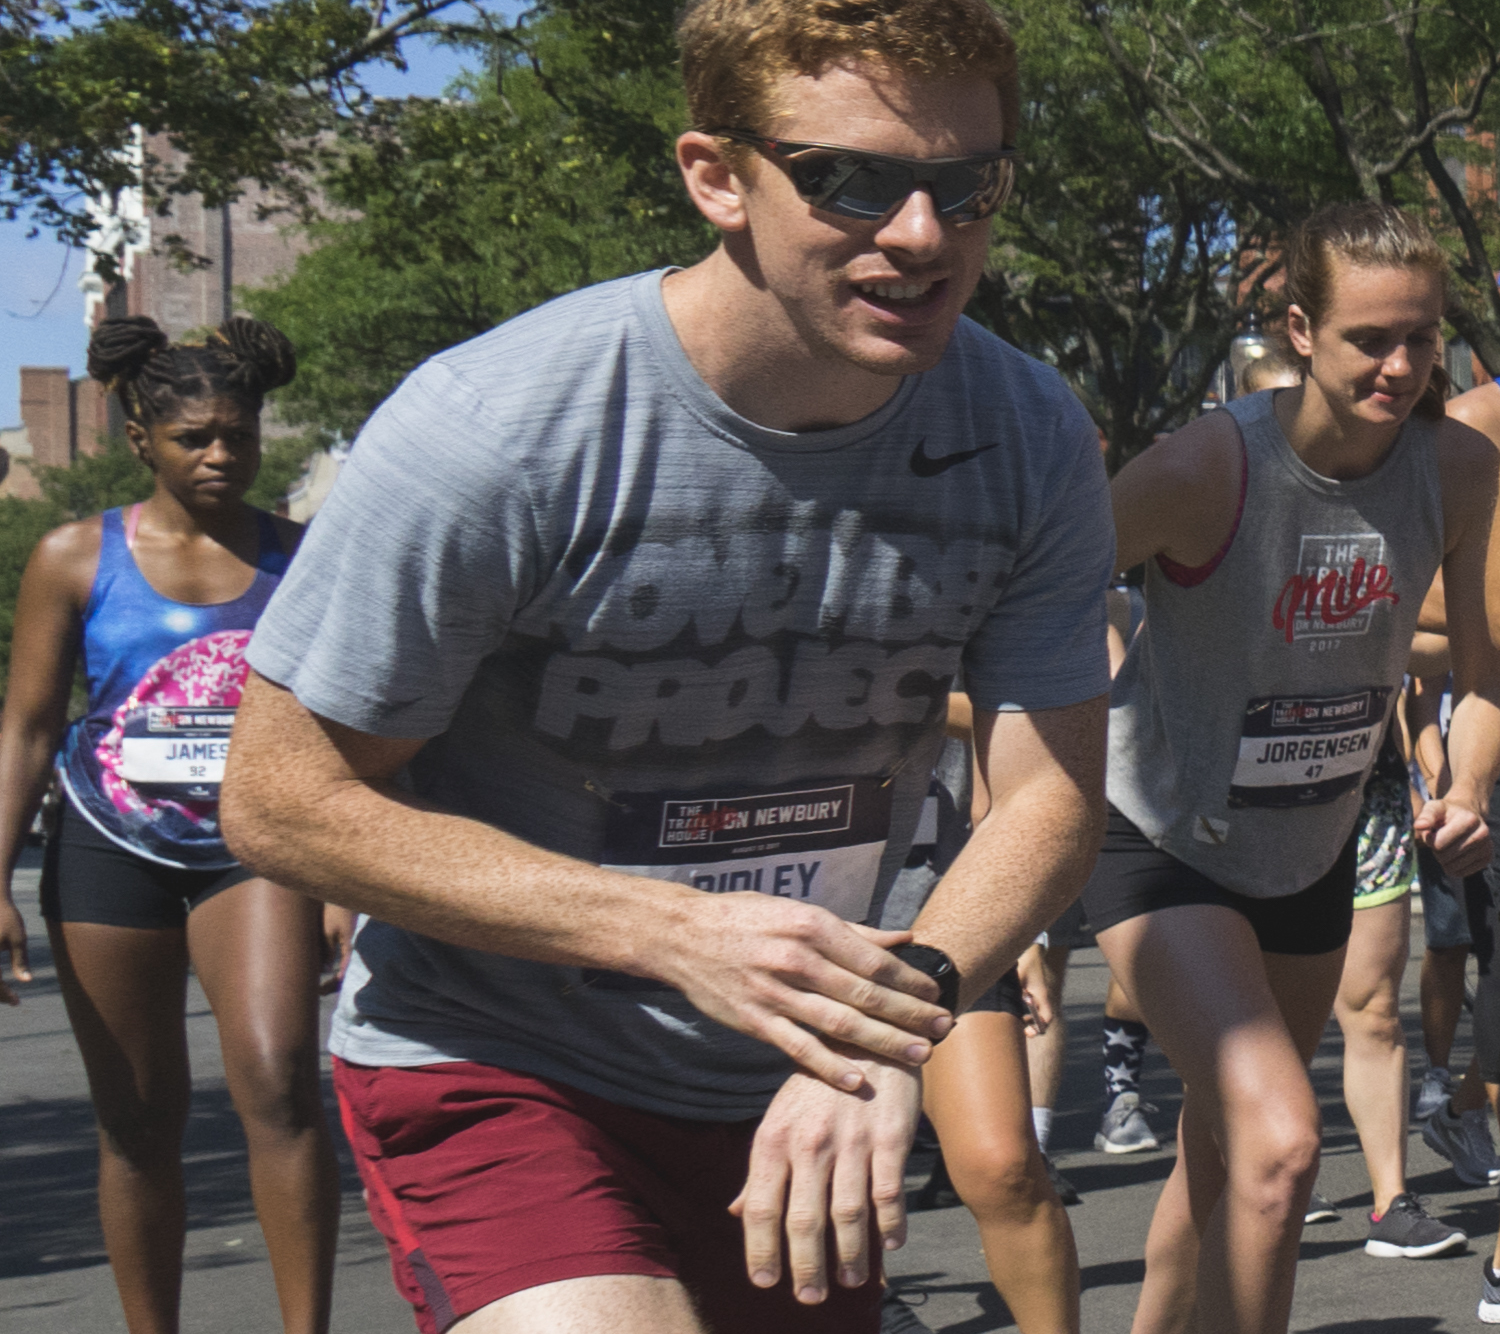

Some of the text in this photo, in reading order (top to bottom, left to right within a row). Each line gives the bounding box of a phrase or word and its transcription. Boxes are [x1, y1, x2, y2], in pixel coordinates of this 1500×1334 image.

[1323, 543, 1360, 563] THE
[1309, 639, 1341, 652] 2017
[165, 742, 230, 760] JAMES
[1256, 731, 1371, 764] JORGENSEN
[188, 766, 207, 777] 92
[1305, 765, 1324, 778] 47
[679, 804, 703, 818] THE
[723, 799, 843, 830] ON NEWBURY
